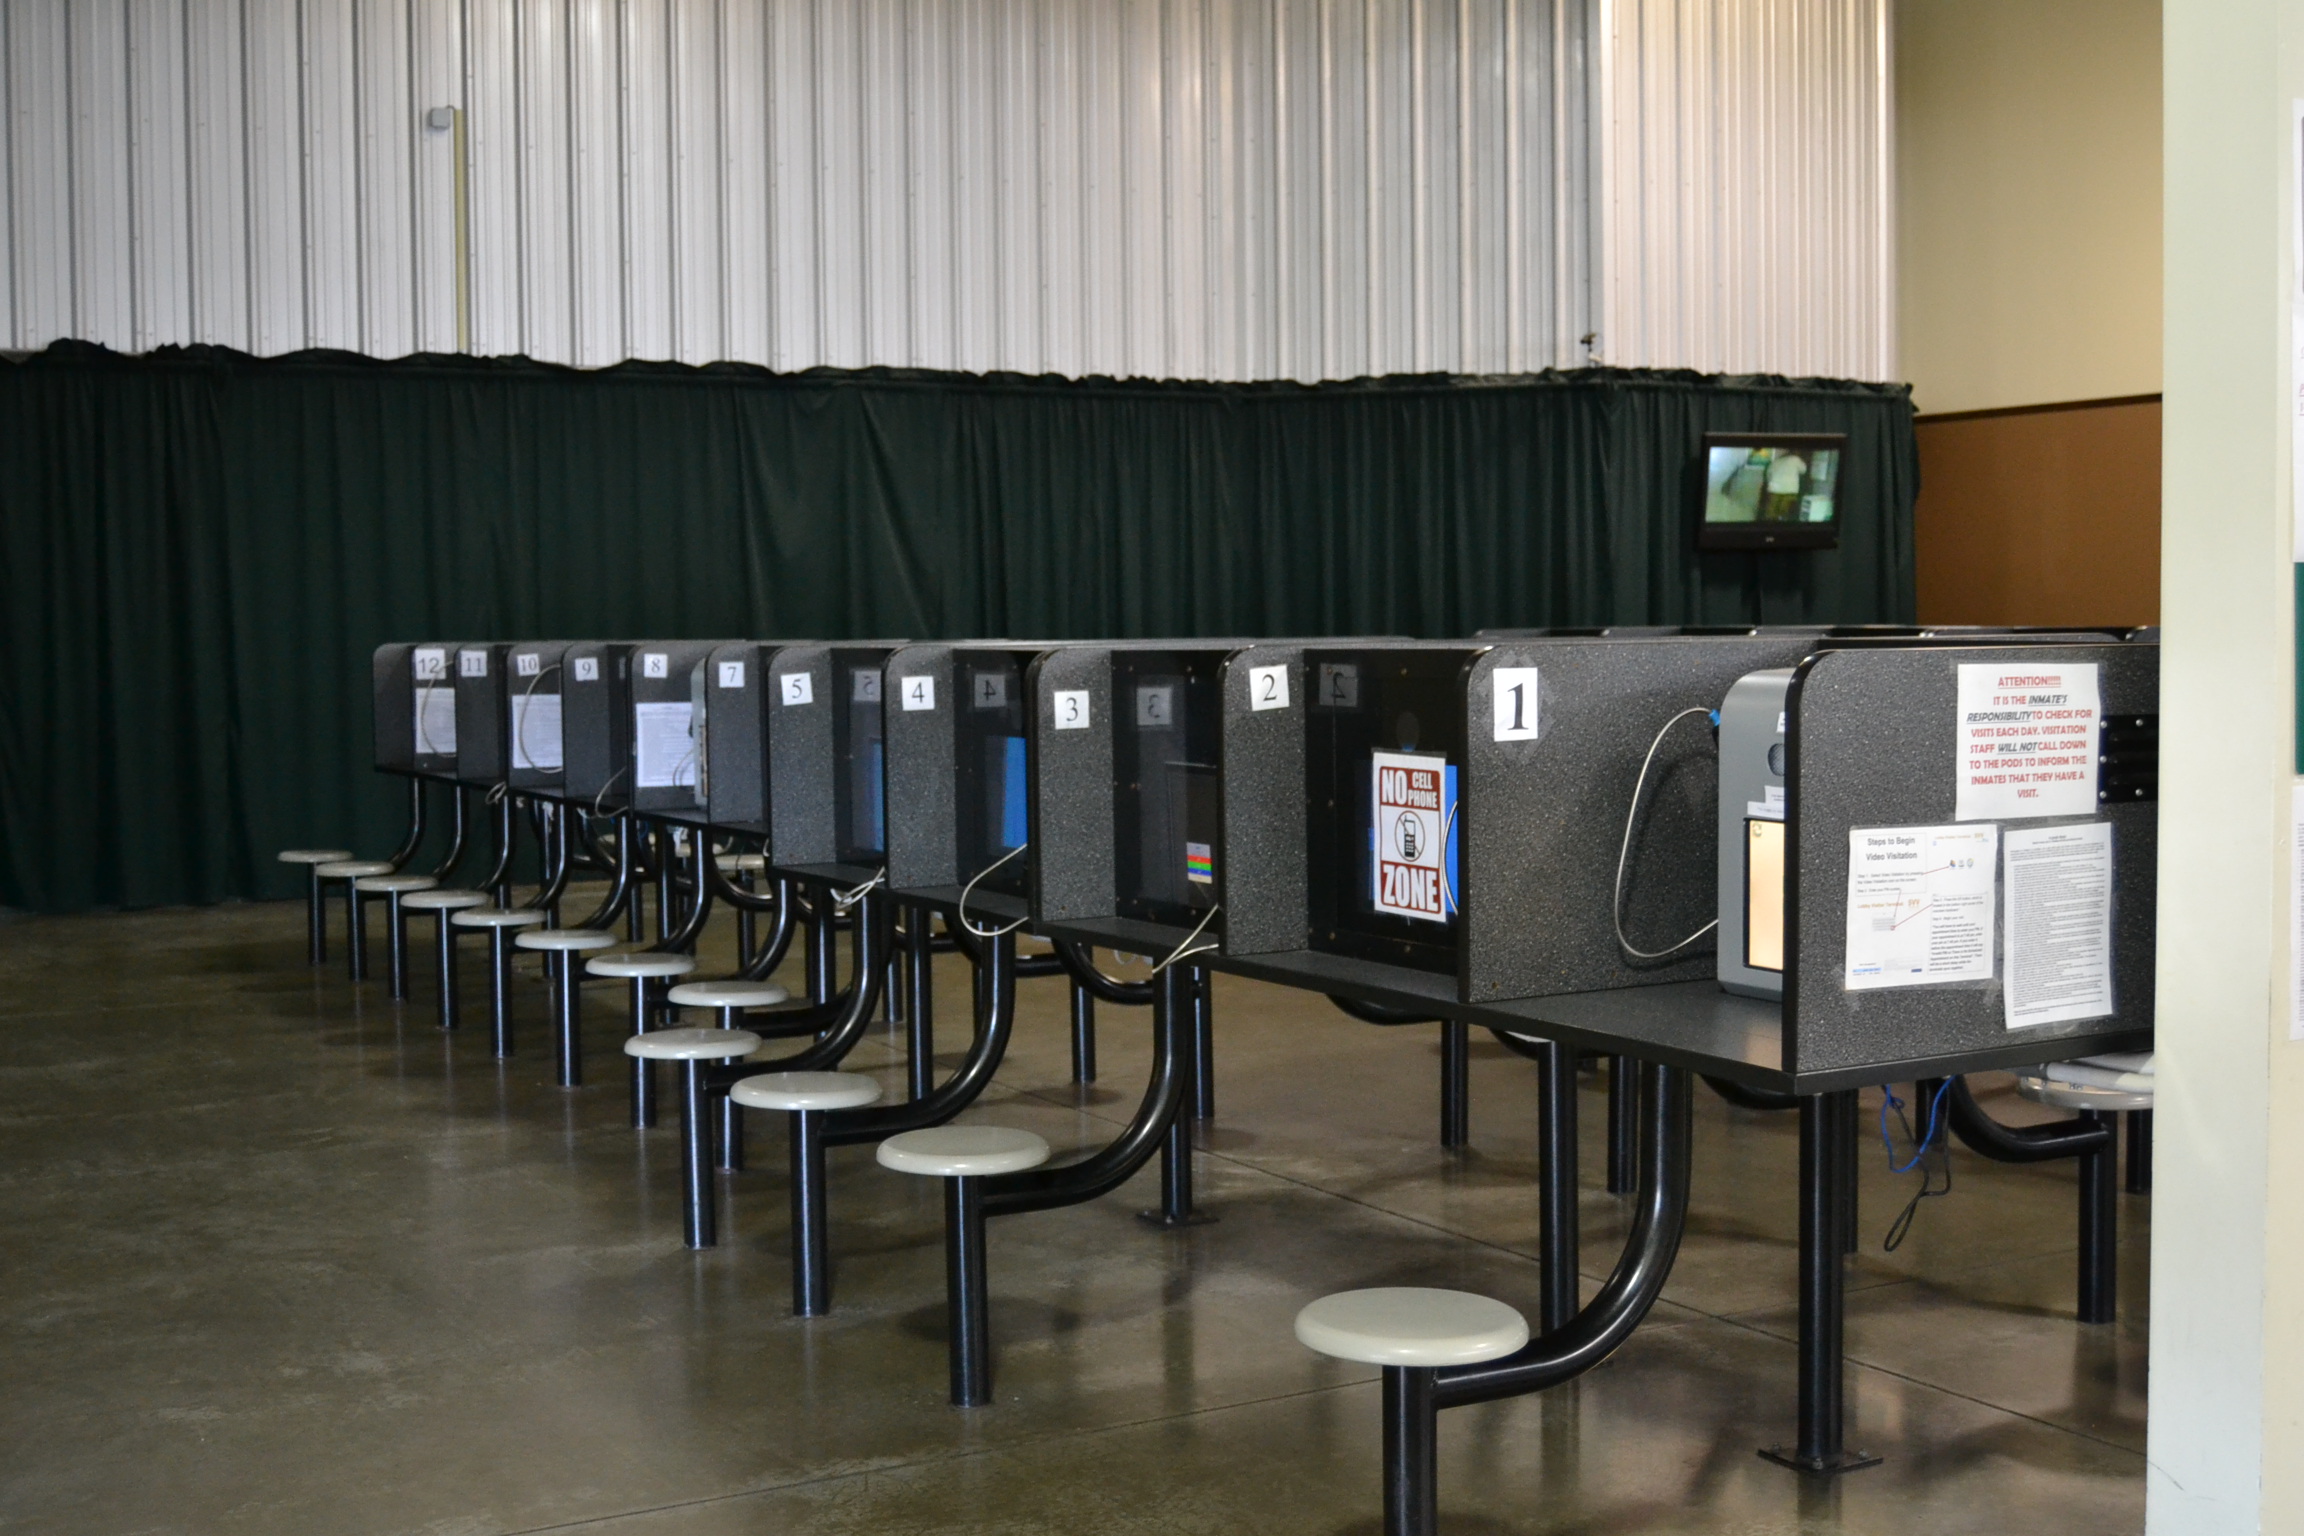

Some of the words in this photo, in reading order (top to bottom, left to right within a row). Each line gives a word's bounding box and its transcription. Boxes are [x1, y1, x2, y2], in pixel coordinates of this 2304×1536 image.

[418, 657, 440, 674] 12
[465, 657, 484, 673] 11
[521, 657, 538, 672] 10
[582, 661, 593, 675] 9
[650, 657, 661, 674] 8
[727, 666, 737, 683] 7
[791, 679, 802, 699] 5
[911, 682, 925, 703] 4
[1262, 673, 1278, 702] 2
[1507, 682, 1529, 730] 1
[1993, 696, 2001, 705] IT
[2002, 696, 2009, 705] IS
[2011, 695, 2026, 705] THE
[2028, 694, 2068, 705] INMATE'S
[1066, 697, 1079, 722] 3
[1966, 711, 2033, 722] RESPONSIBILITY
[2033, 711, 2043, 720] TO
[2045, 710, 2073, 720] CHECK
[2074, 709, 2092, 719] FOR
[1971, 728, 1994, 738] VISITS
[1996, 727, 2019, 737] EACH
[2021, 726, 2040, 736] DAY.
[2041, 725, 2086, 735] VISITATION
[1970, 744, 1995, 753] STAFF
[1998, 742, 2017, 752] WILL
[2019, 742, 2038, 752] NOT
[2038, 741, 2057, 751] CALL
[2059, 740, 2086, 750] DOWN
[1969, 760, 1981, 769] TO
[1983, 759, 1999, 769] THE
[2001, 758, 2023, 768] PODS
[2025, 757, 2036, 767] TO
[2037, 756, 2069, 767] INFORM
[2071, 755, 2087, 765] THE
[1412, 771, 1433, 790] CELL
[1971, 774, 2006, 785] INMATES
[2008, 773, 2030, 783] THAT
[2032, 772, 2053, 782] THEY
[2054, 771, 2077, 781] HAVE
[2078, 771, 2085, 780] A
[1381, 769, 1408, 806] NO
[2017, 788, 2039, 798] VISIT.
[1408, 789, 1438, 809] PHONE
[1867, 838, 1886, 846] Steps
[1887, 837, 1895, 845] to
[1896, 836, 1916, 846] Begin
[1865, 852, 1885, 861] Video
[1886, 851, 1918, 860] Visitation
[1383, 863, 1439, 912] ZONE
